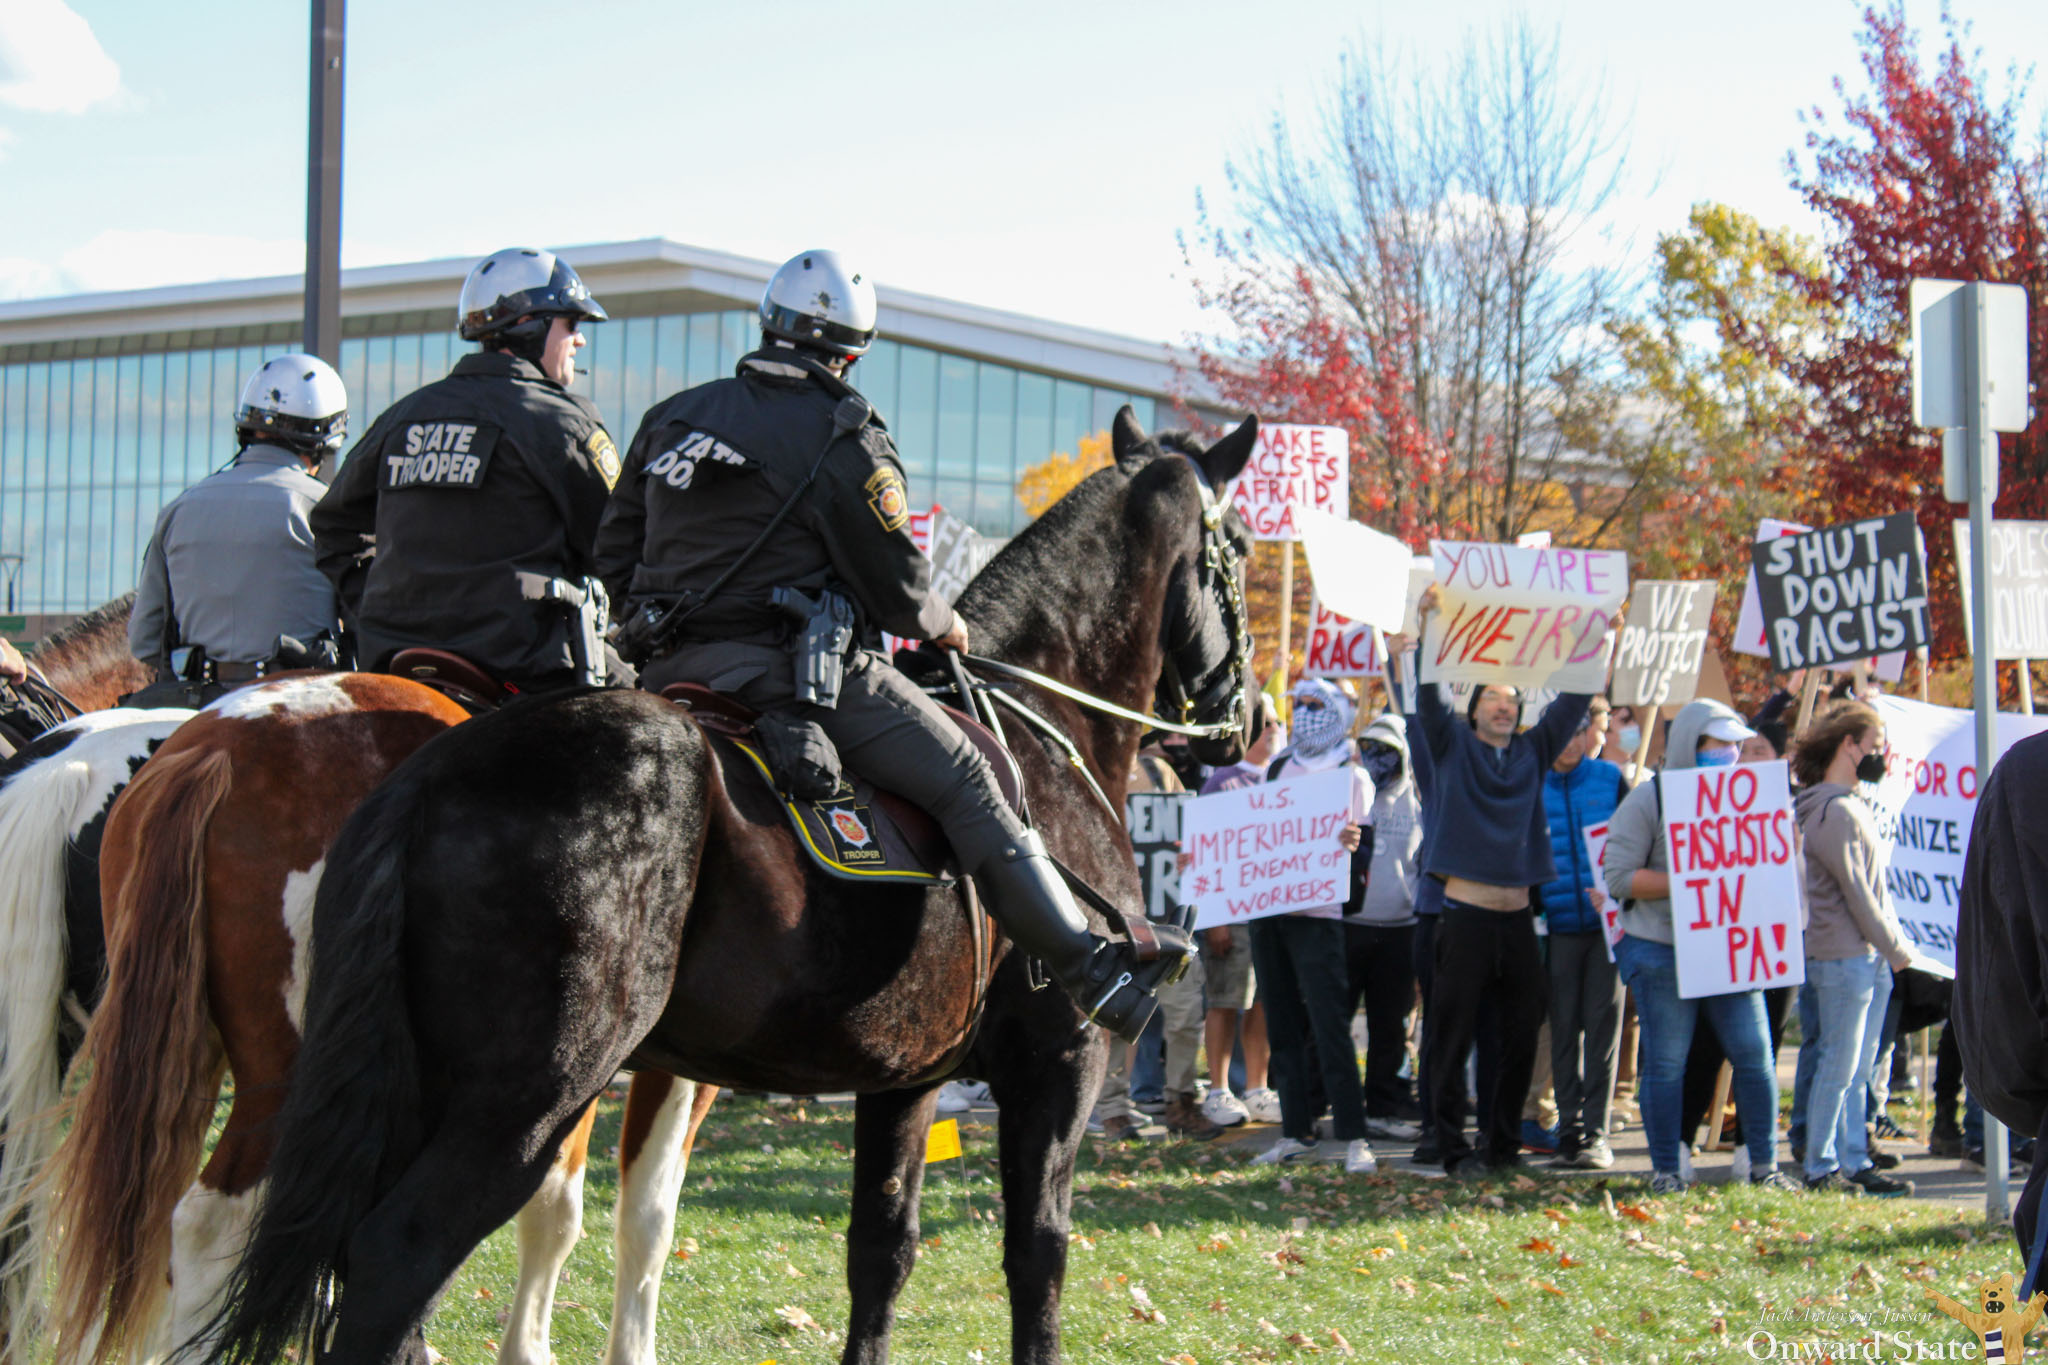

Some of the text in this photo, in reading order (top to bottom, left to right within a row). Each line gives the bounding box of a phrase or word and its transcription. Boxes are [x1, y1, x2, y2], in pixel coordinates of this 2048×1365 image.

[406, 423, 478, 456] STATE
[387, 451, 481, 487] TROOPER
[1242, 452, 1339, 481] ACISTS
[1233, 480, 1330, 507] AFRAID
[1437, 543, 1612, 595] YOU ARE
[1765, 518, 1886, 578] SHUT
[1651, 582, 1701, 631] WE
[1781, 552, 1909, 618] DOWN
[1434, 602, 1609, 668] WEIRD
[1614, 625, 1708, 675] PROTECT
[1773, 596, 1928, 670] RACIST
[1636, 668, 1673, 707] US
[1248, 787, 1295, 810] U.S.
[1696, 767, 1759, 818] NO
[1904, 757, 1949, 798] FOR
[843, 849, 881, 860] TROOPER
[1189, 805, 1352, 872] IMPERIALISM
[1669, 808, 1789, 874] FASCISTS
[1192, 849, 1346, 898] #1 ENEMY OF
[1226, 879, 1338, 917] WORKERS
[1685, 873, 1745, 931] IN
[1727, 923, 1788, 984] PA!
